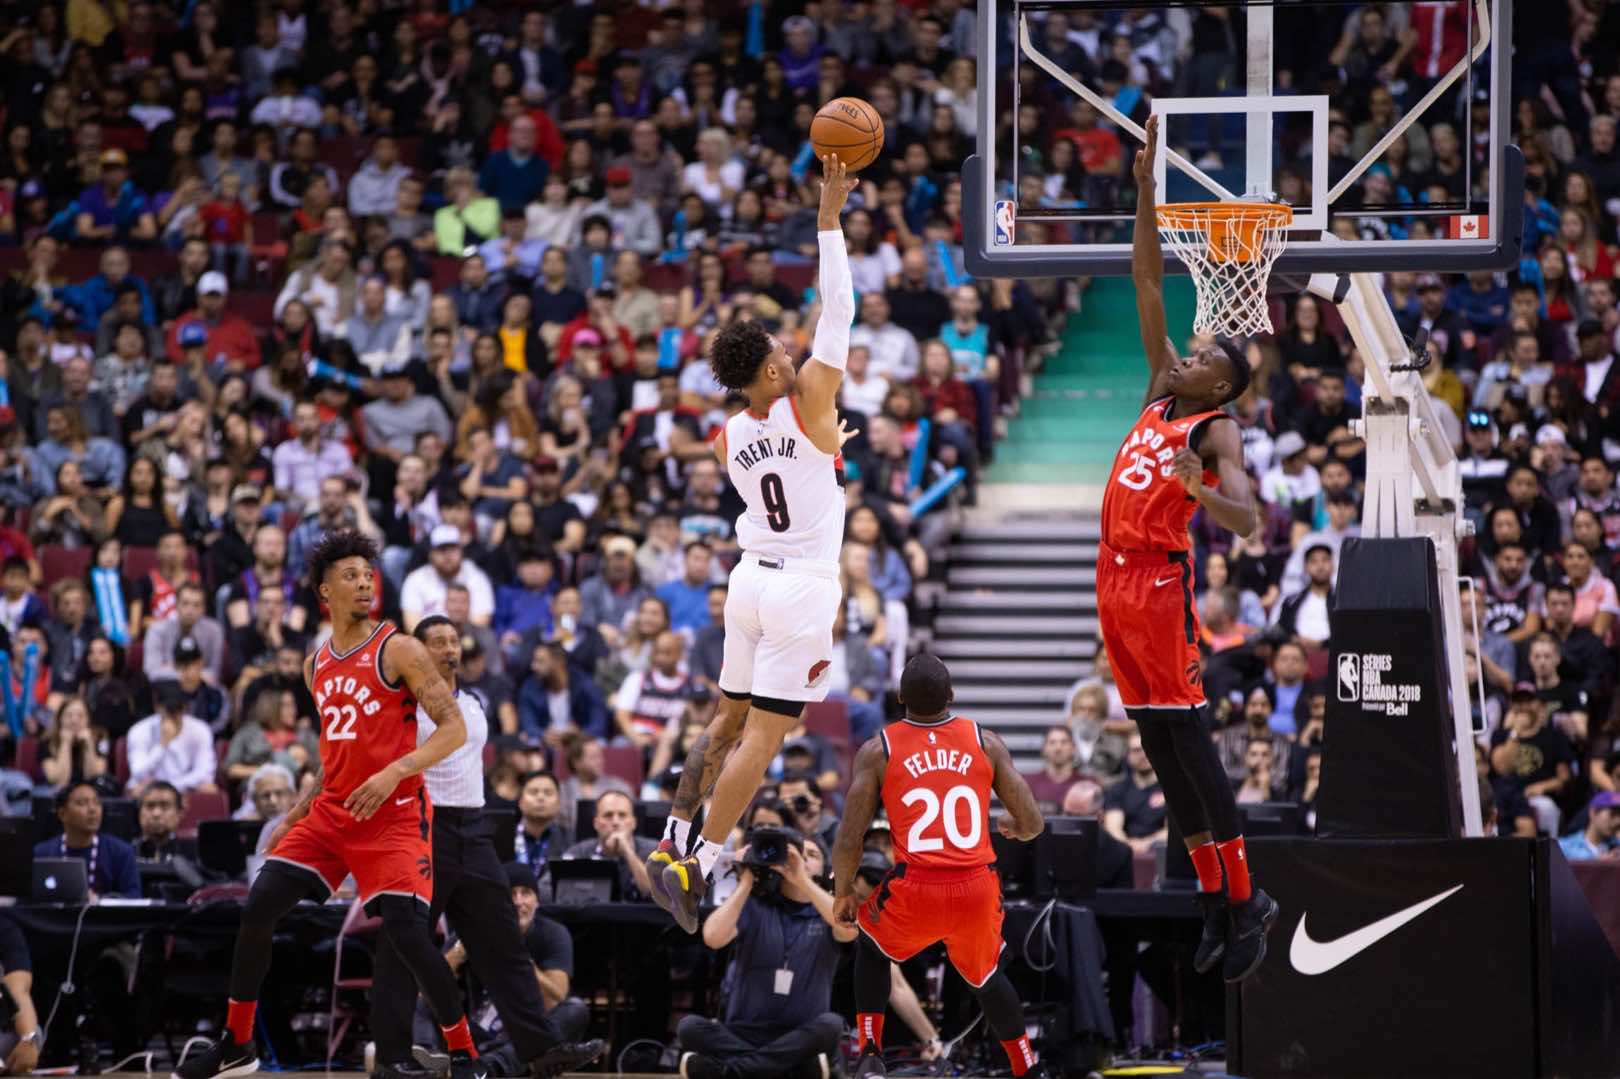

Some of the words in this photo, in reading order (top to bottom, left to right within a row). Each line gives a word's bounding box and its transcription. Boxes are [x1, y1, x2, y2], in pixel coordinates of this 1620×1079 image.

[734, 438, 774, 471] TRENT
[778, 437, 798, 460] JR.
[1118, 451, 1156, 491] 25
[760, 472, 791, 533] 9
[1362, 670, 1381, 686] NBA
[1362, 685, 1398, 701] CANADA
[1398, 685, 1421, 702] 2018
[316, 676, 381, 716] APTORS
[1386, 702, 1408, 716] Bell
[323, 704, 358, 741] 22
[903, 749, 973, 779] FELDER
[901, 785, 982, 853] 20
